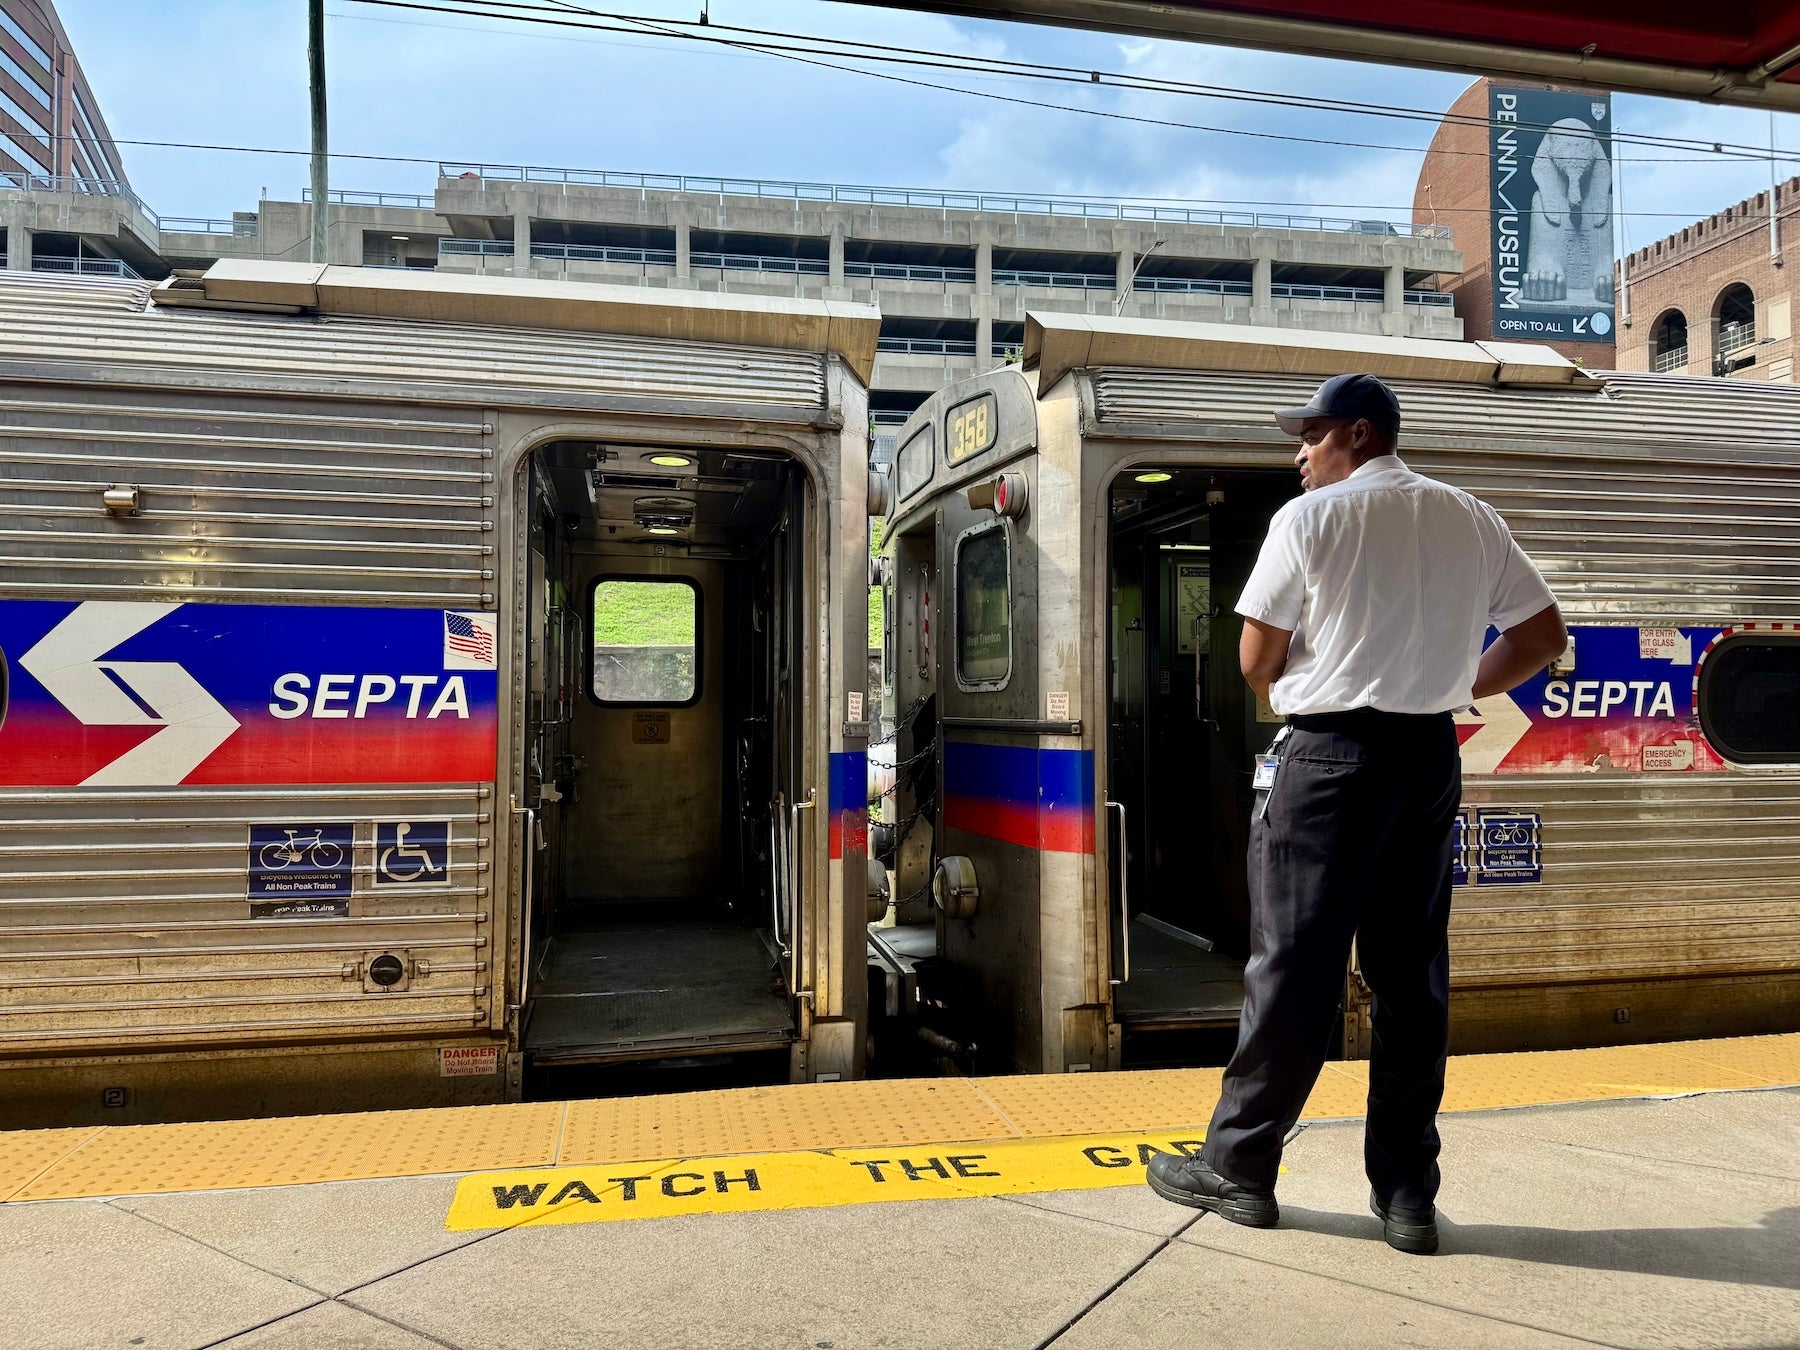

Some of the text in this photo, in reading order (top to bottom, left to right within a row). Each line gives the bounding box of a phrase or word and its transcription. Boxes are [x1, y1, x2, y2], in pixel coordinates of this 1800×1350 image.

[1500, 320, 1564, 332] OPEN TO ALL
[954, 403, 988, 459] 358
[1655, 629, 1677, 637] ENTRY
[1652, 639, 1675, 647] GLASS
[269, 673, 471, 720] SEPTA
[1542, 681, 1675, 718] SEPTA
[1645, 750, 1686, 758] EMERGENCY
[1645, 759, 1672, 767] ACCESS
[264, 882, 337, 891] All Non Peak Trains
[444, 1048, 496, 1059] DANGER
[491, 1169, 762, 1209] WATCH
[850, 1154, 1001, 1183] THE
